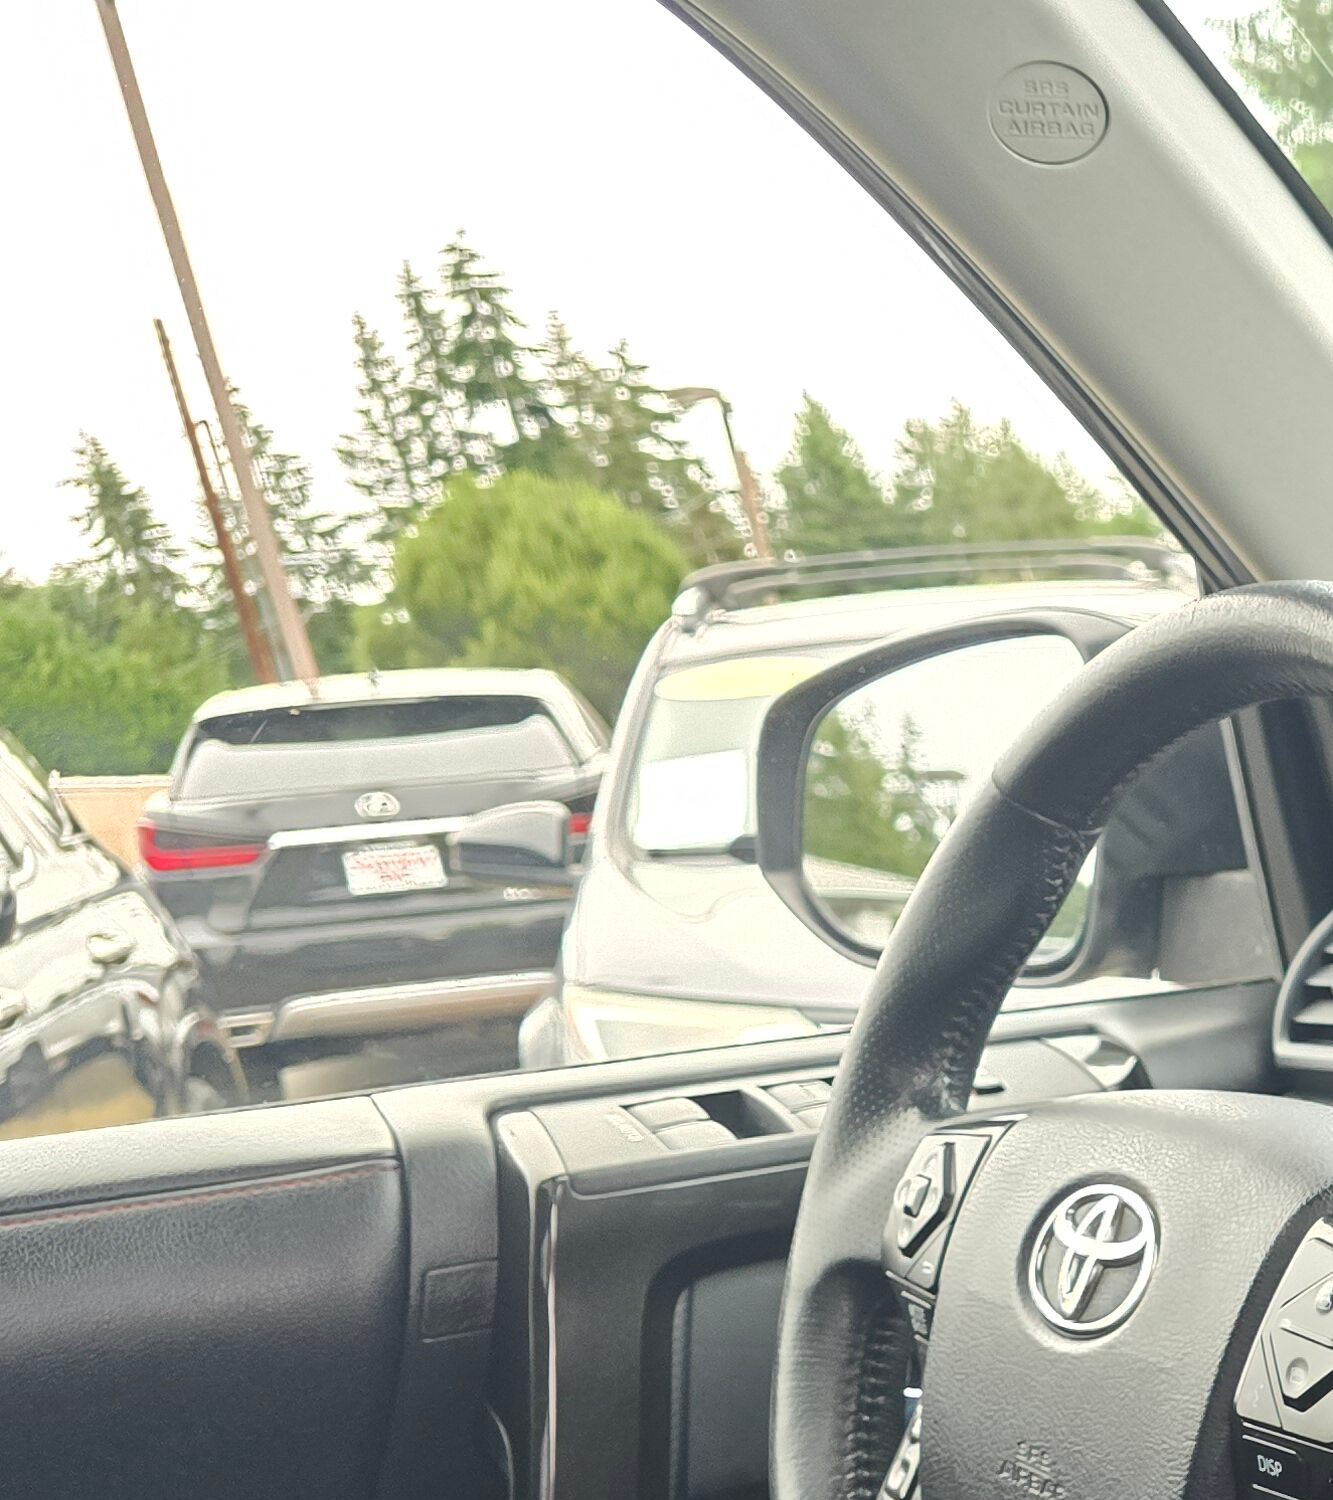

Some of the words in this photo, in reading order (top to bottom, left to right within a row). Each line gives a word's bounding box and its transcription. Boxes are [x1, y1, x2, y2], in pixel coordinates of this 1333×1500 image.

[1023, 79, 1069, 96] SRS
[998, 100, 1100, 118] CURTAIN
[1007, 120, 1096, 137] AIRBAG
[1257, 1454, 1282, 1477] DISP
